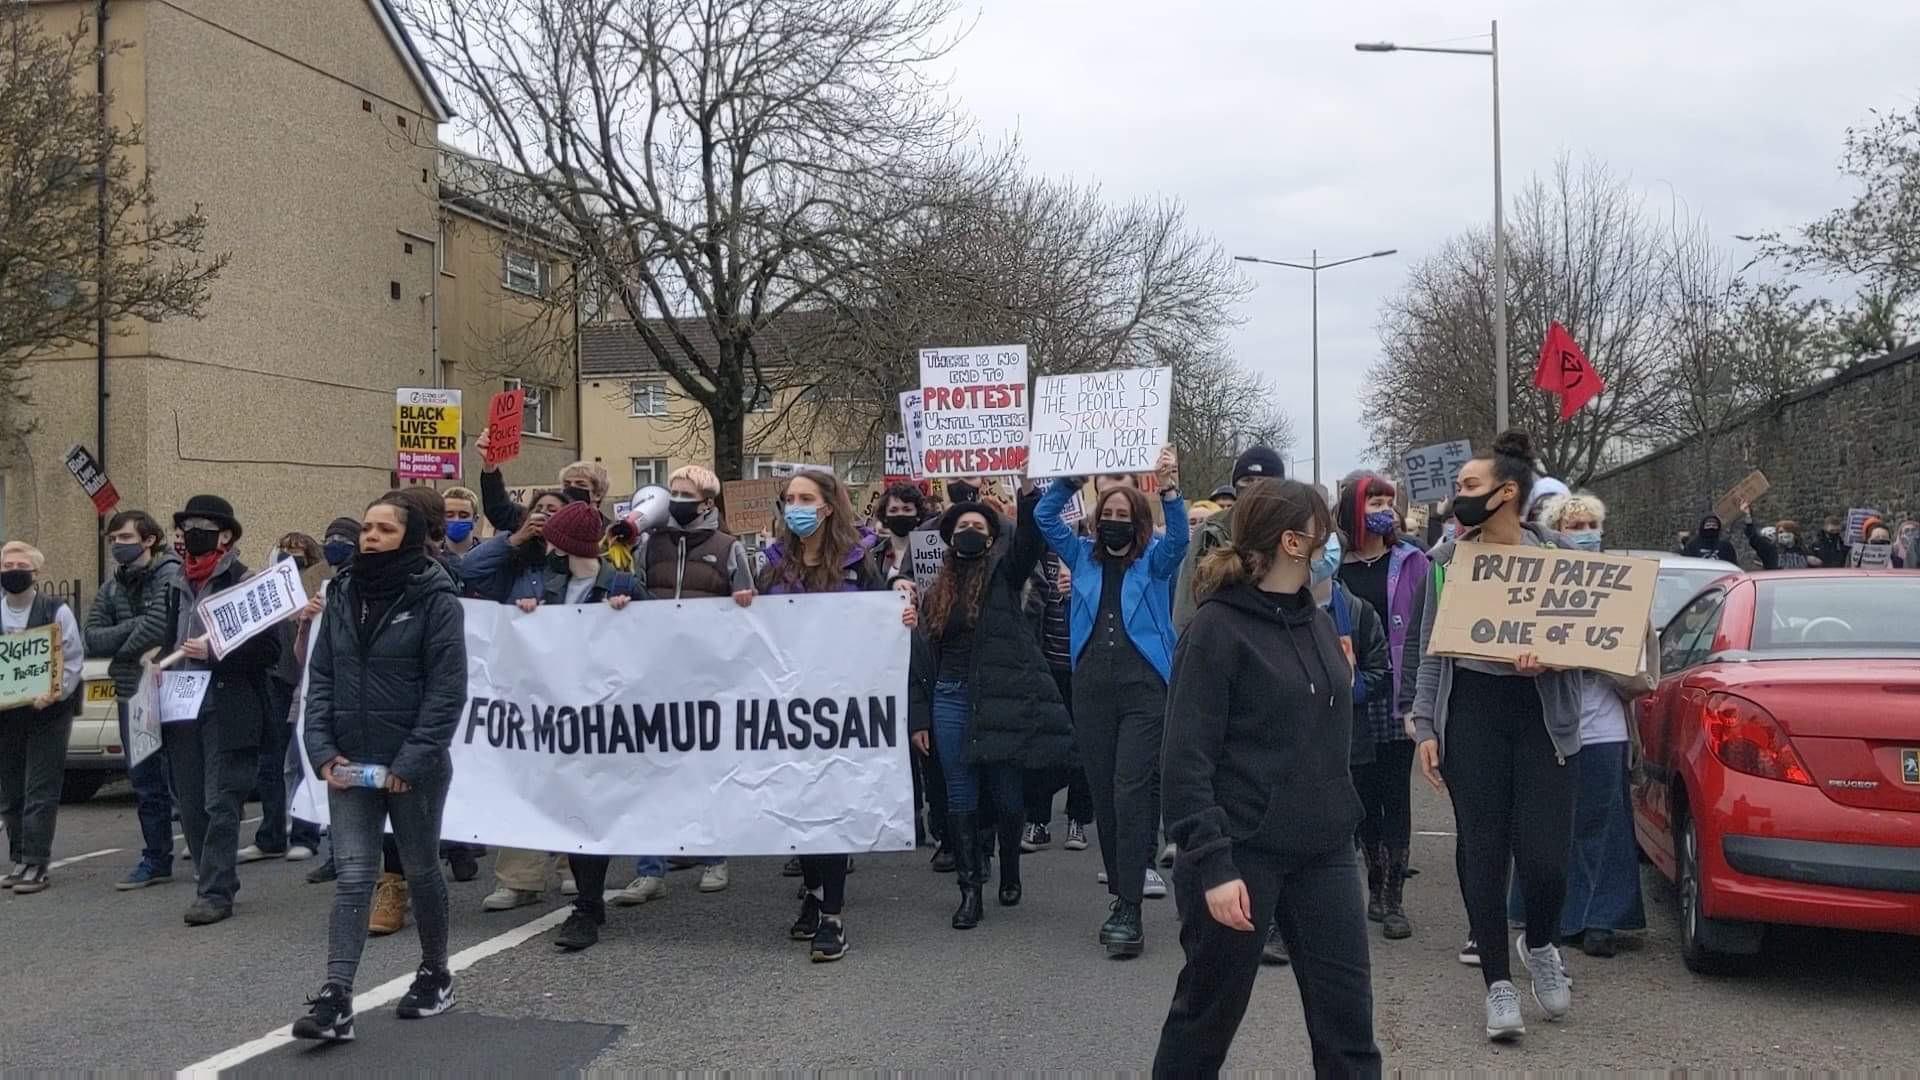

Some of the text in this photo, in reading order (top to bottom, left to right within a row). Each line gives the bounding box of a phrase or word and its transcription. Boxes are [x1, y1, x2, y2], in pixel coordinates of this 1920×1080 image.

[923, 351, 1020, 368] THERE IS NO
[949, 368, 1005, 384] END TO
[1044, 368, 1164, 396] THE POWER OF
[497, 394, 515, 416] NO
[923, 383, 1026, 412] PROTEST
[1040, 387, 1160, 415] THE PEOPLE IS
[400, 406, 445, 420] BLACK
[924, 412, 975, 431] UNTIL
[978, 413, 1028, 429] THERE
[1057, 408, 1147, 433] STRONGER
[400, 420, 438, 434] LIVES
[490, 423, 517, 441] POLICE
[400, 434, 457, 450] MATTER
[885, 432, 906, 448] Bla
[928, 430, 1024, 447] IS AN END TO
[1034, 427, 1160, 453] THAN THE PEOPLE
[400, 452, 441, 463] No justice
[487, 441, 520, 462] STATE
[885, 448, 909, 462] Live
[924, 445, 1029, 474] OPPRESSION
[1050, 447, 1149, 472] IN POWER
[400, 462, 437, 473] No peace
[885, 461, 912, 475] Mat
[1406, 454, 1430, 499] BILL
[1428, 457, 1446, 489] THE
[914, 547, 945, 560] Justi
[1472, 554, 1633, 591] PRITI PATEL
[1508, 587, 1610, 610] IS NOT
[1471, 618, 1625, 650] ONE OF US
[0, 637, 50, 664] RIGHTS
[13, 661, 52, 681] PROTEST
[464, 695, 898, 754] FOR MOHAMUD HASSAN
[1828, 780, 1879, 789] PEUGEOT
